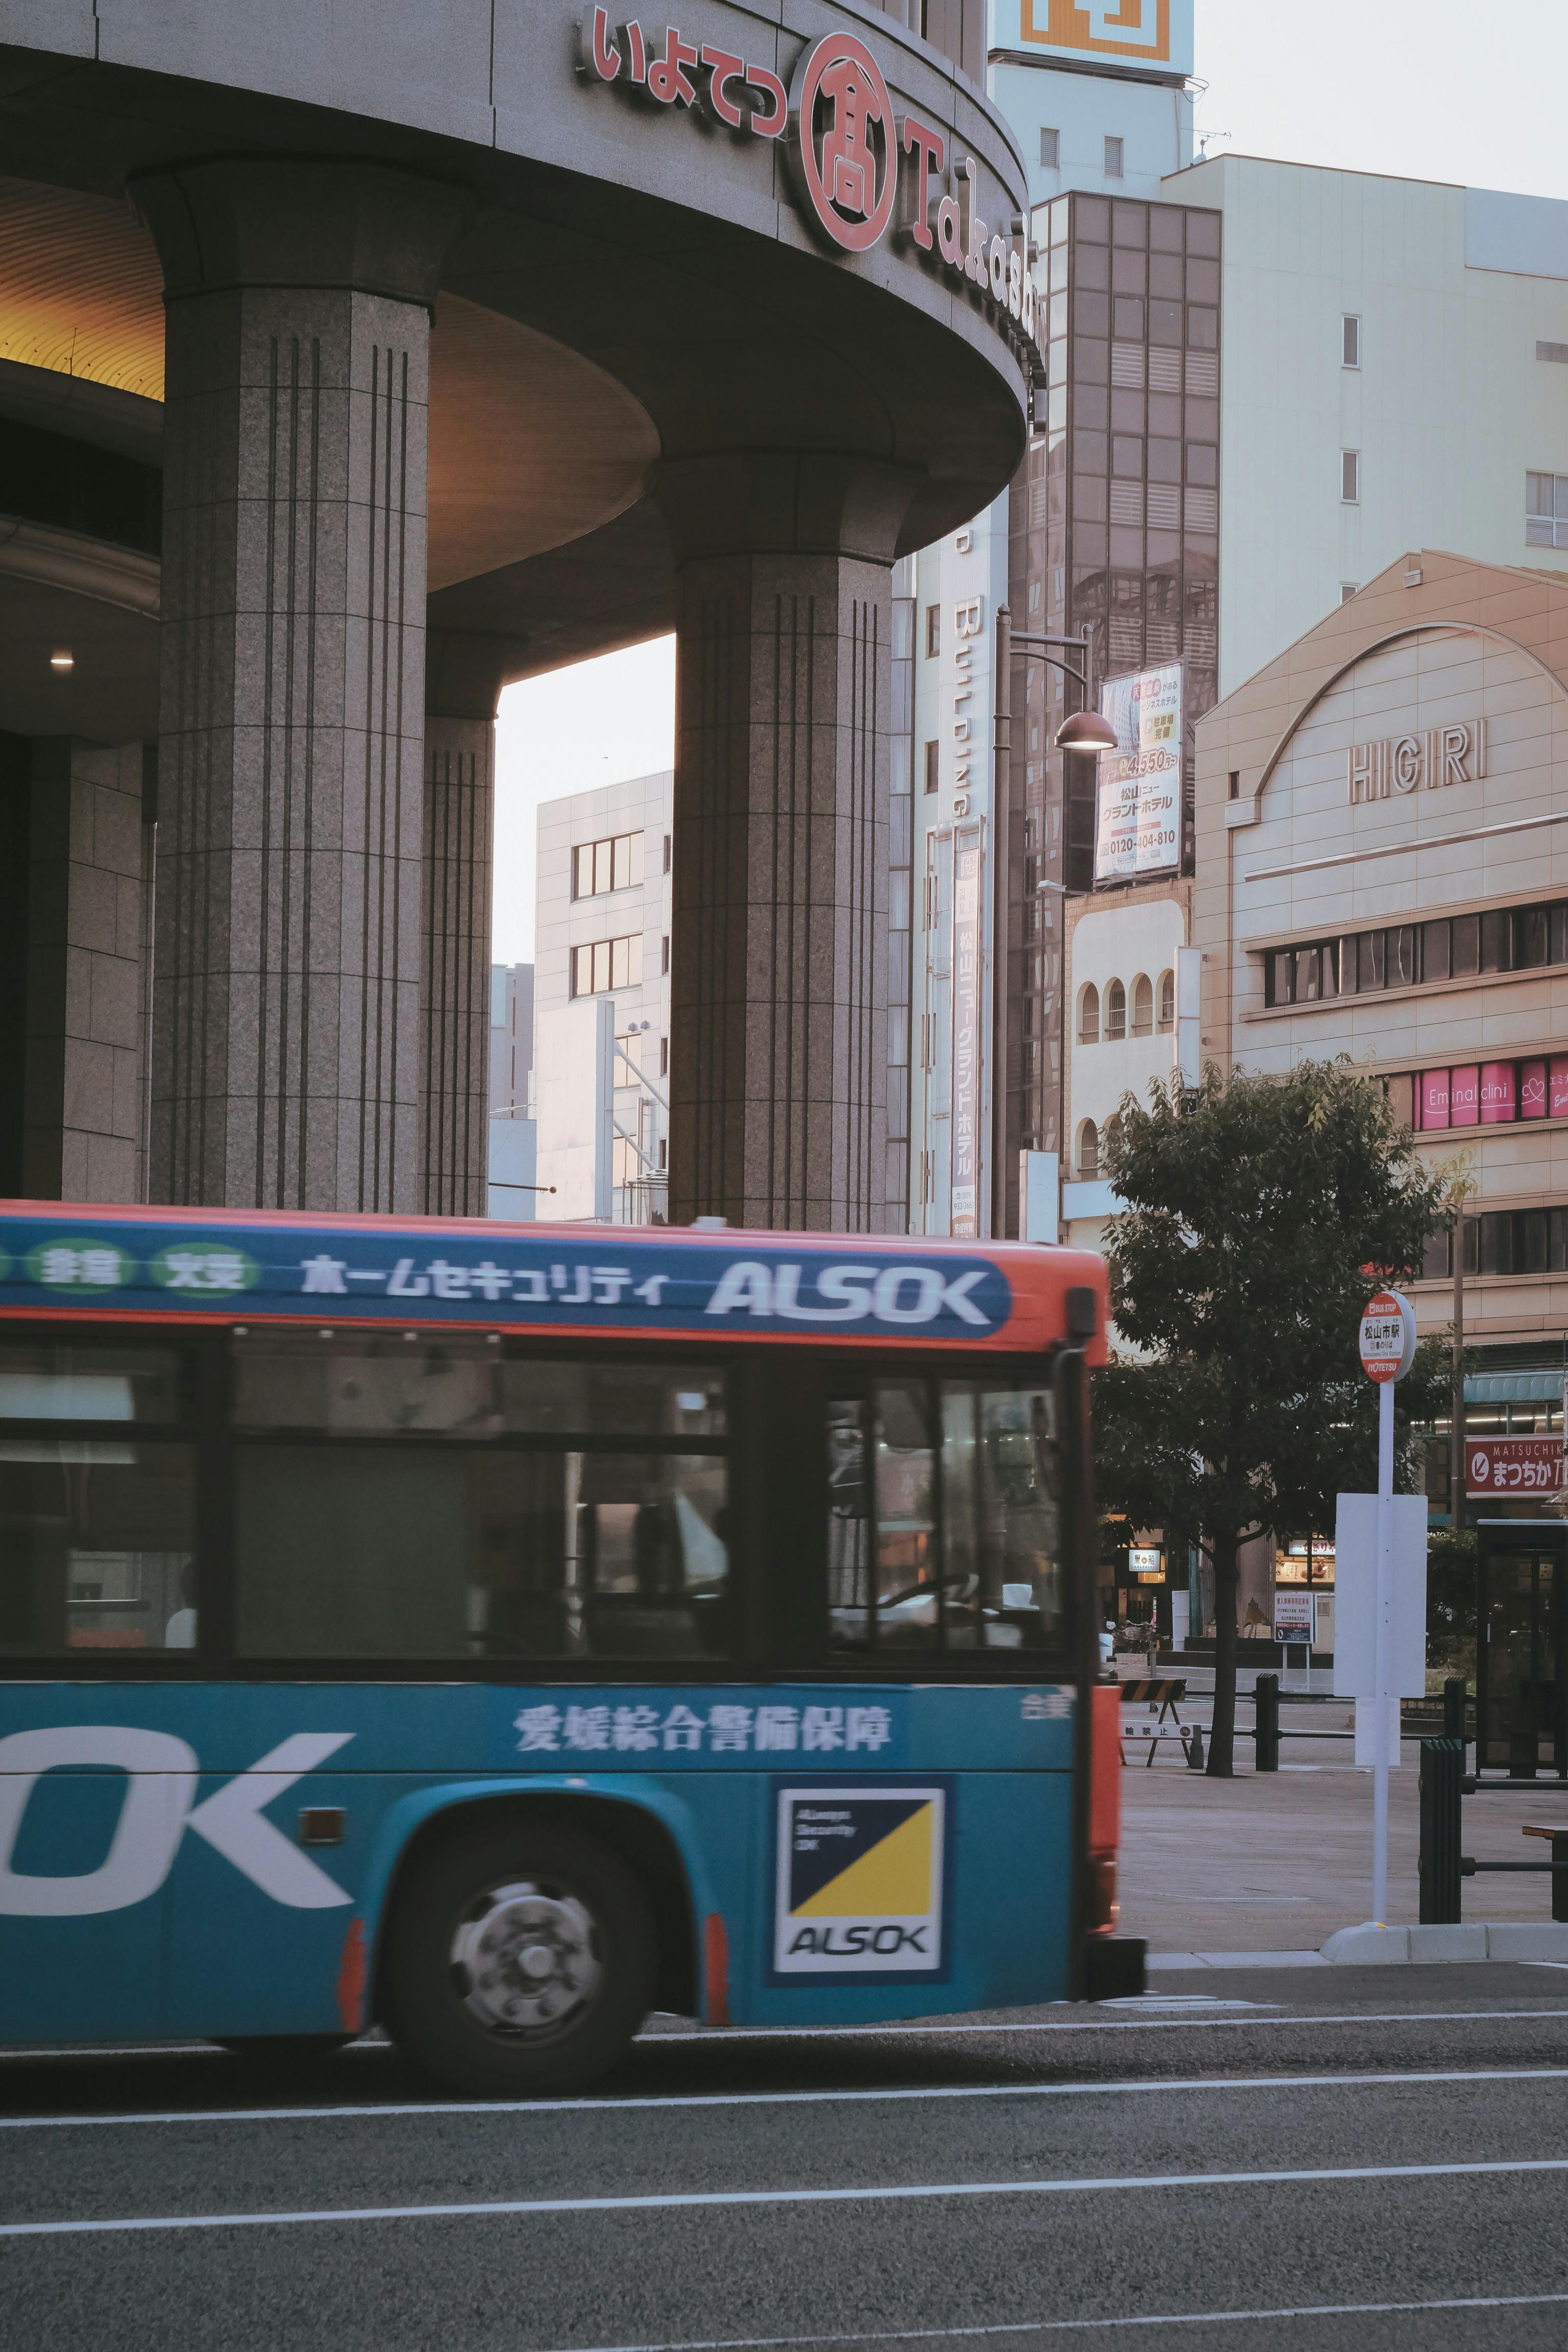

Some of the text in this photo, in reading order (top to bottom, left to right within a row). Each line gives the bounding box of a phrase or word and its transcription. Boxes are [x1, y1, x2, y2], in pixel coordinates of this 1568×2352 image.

[591, 4, 788, 138] いよてつ
[952, 595, 984, 817] BUILDING
[1155, 726, 1170, 740] 完備
[1346, 718, 1488, 805] HIGIRI
[1110, 829, 1175, 854] 0120-404-810
[958, 930, 974, 1177] 松山ニューグランドホテル
[1430, 1083, 1529, 1106] Eminal clinic
[954, 1201, 974, 1210] 933-3661
[301, 1254, 992, 1325] ホームセキュリティ ALSOK
[1375, 1303, 1396, 1313] BUS STOP
[1365, 1324, 1400, 1340] 松山市駅
[1368, 1362, 1397, 1373] IYOTETSU
[512, 1704, 892, 1752] 愛媛綜合警備保障
[788, 1924, 929, 1955] ALSOK
